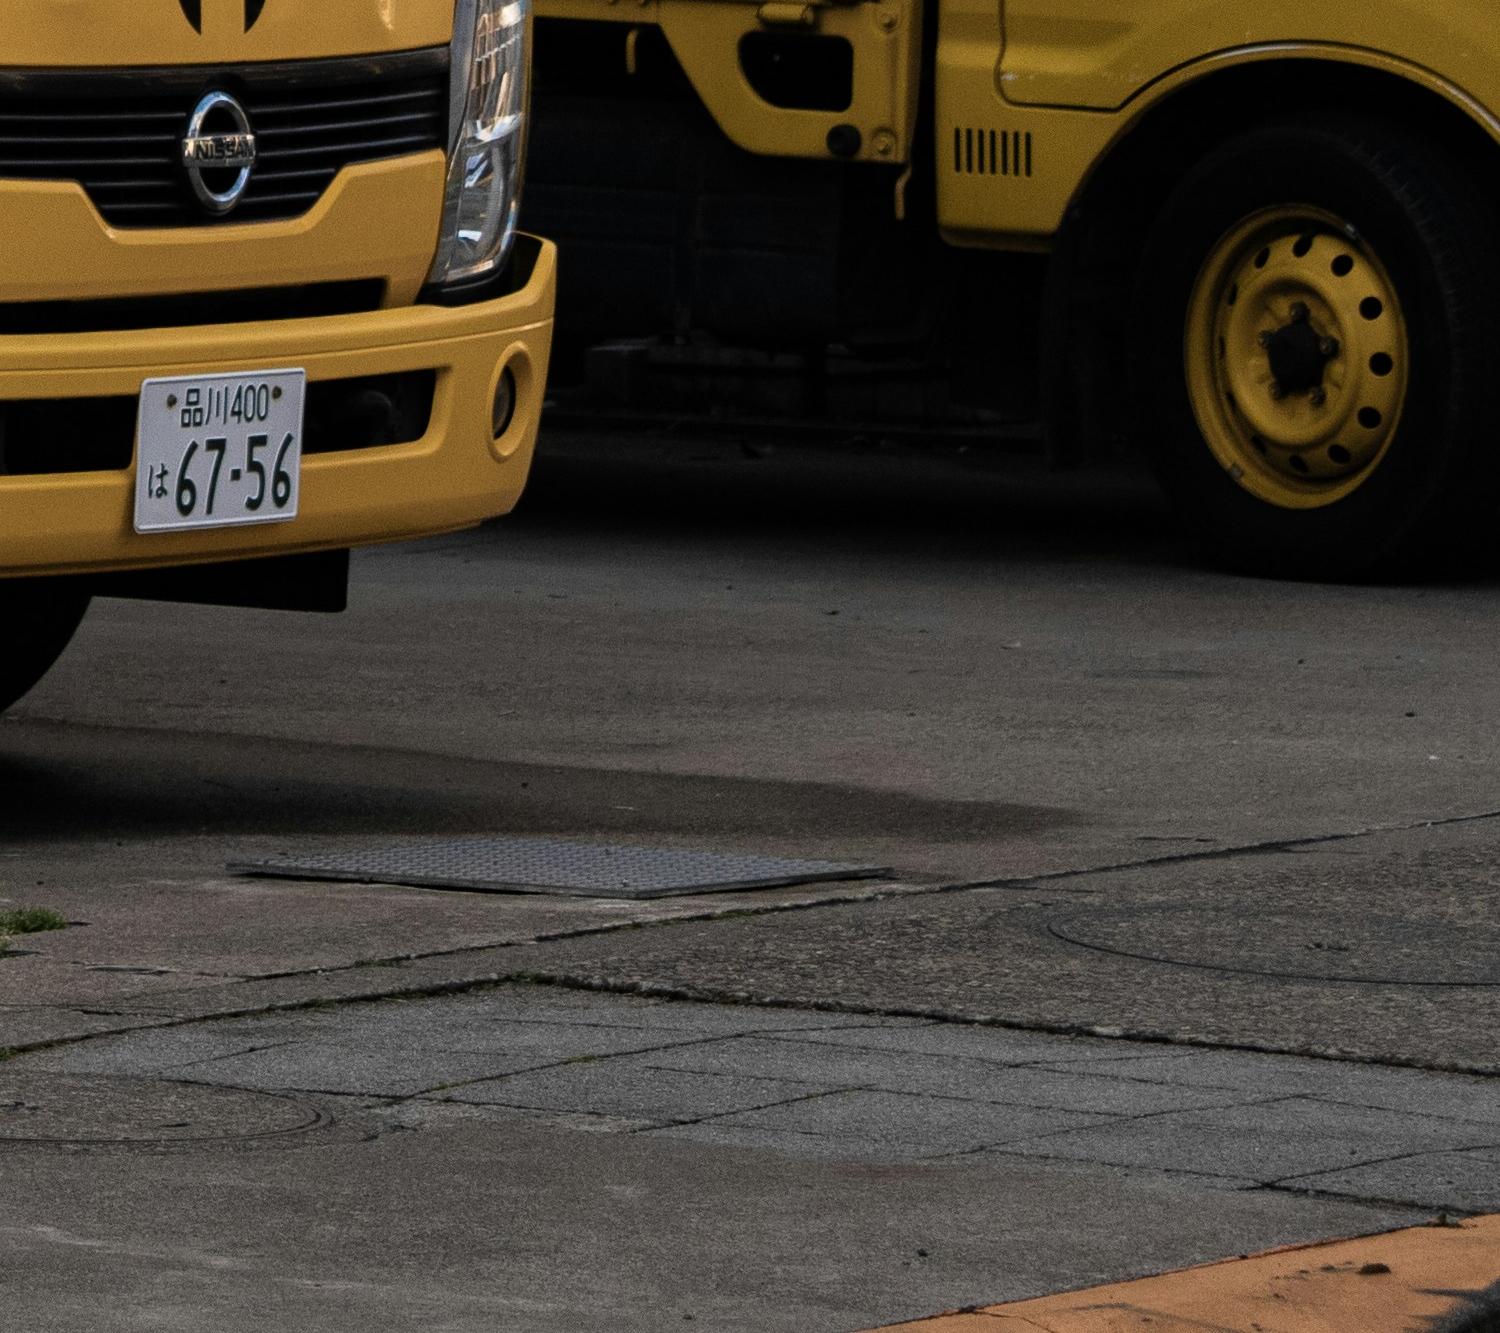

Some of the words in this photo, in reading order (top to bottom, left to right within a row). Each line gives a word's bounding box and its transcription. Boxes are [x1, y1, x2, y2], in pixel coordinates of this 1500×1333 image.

[196, 135, 254, 160] NISSAN
[148, 463, 169, 498] は
[175, 432, 294, 516] 67-56
